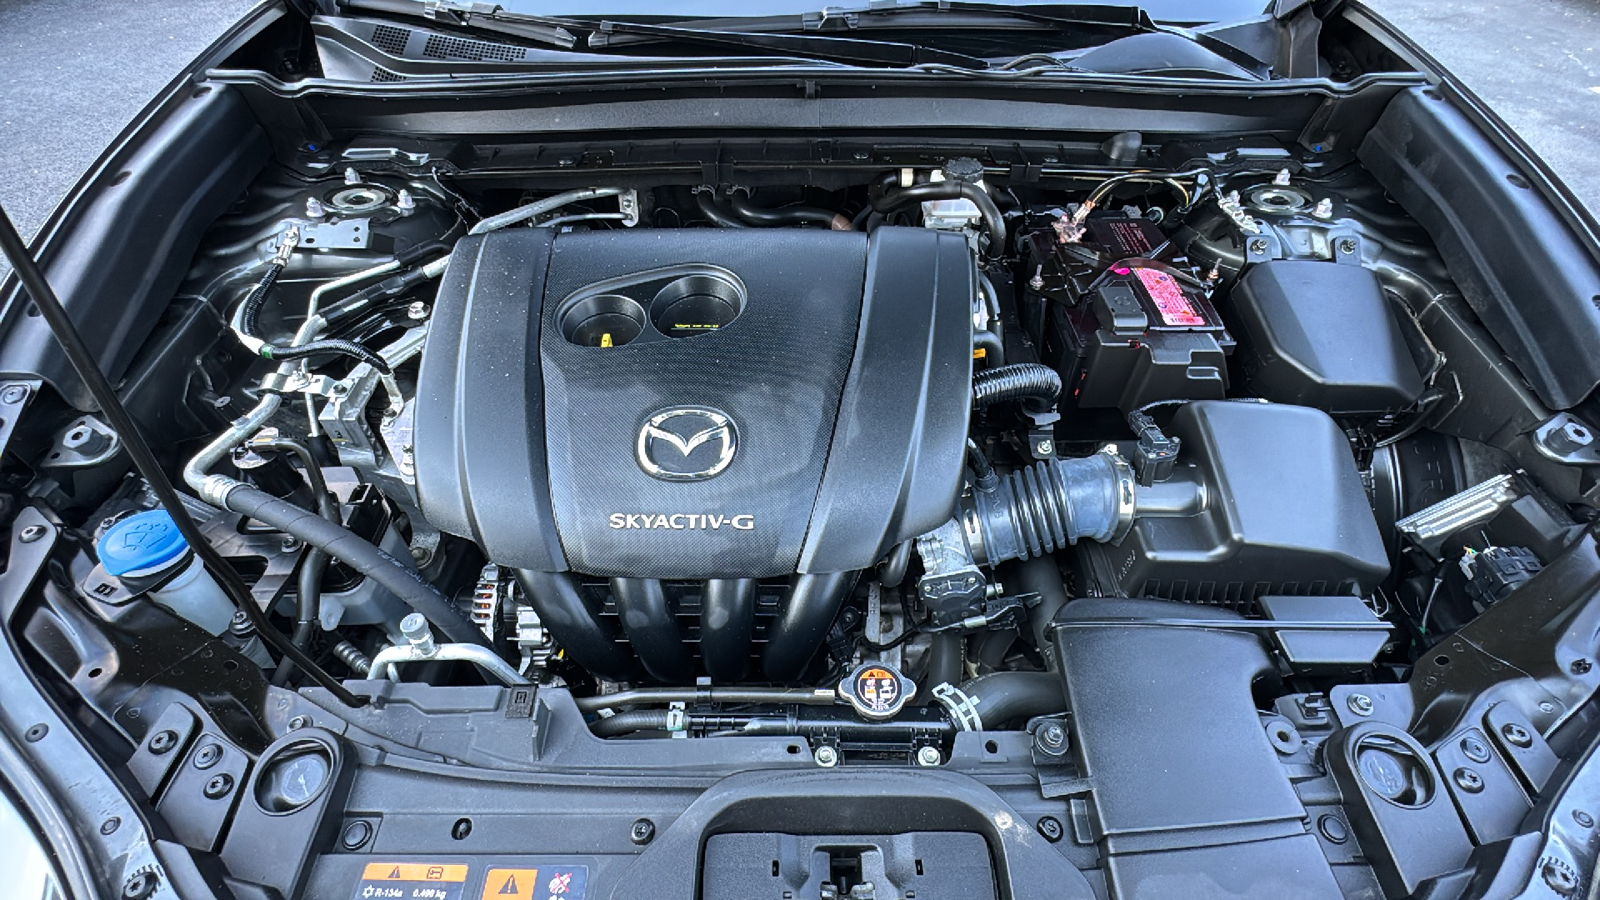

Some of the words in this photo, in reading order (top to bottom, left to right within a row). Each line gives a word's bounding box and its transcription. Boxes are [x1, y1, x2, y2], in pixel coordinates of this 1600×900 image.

[609, 512, 754, 530] SKYACTIV-G
[375, 888, 404, 898] R-134a
[435, 888, 447, 900] kg
